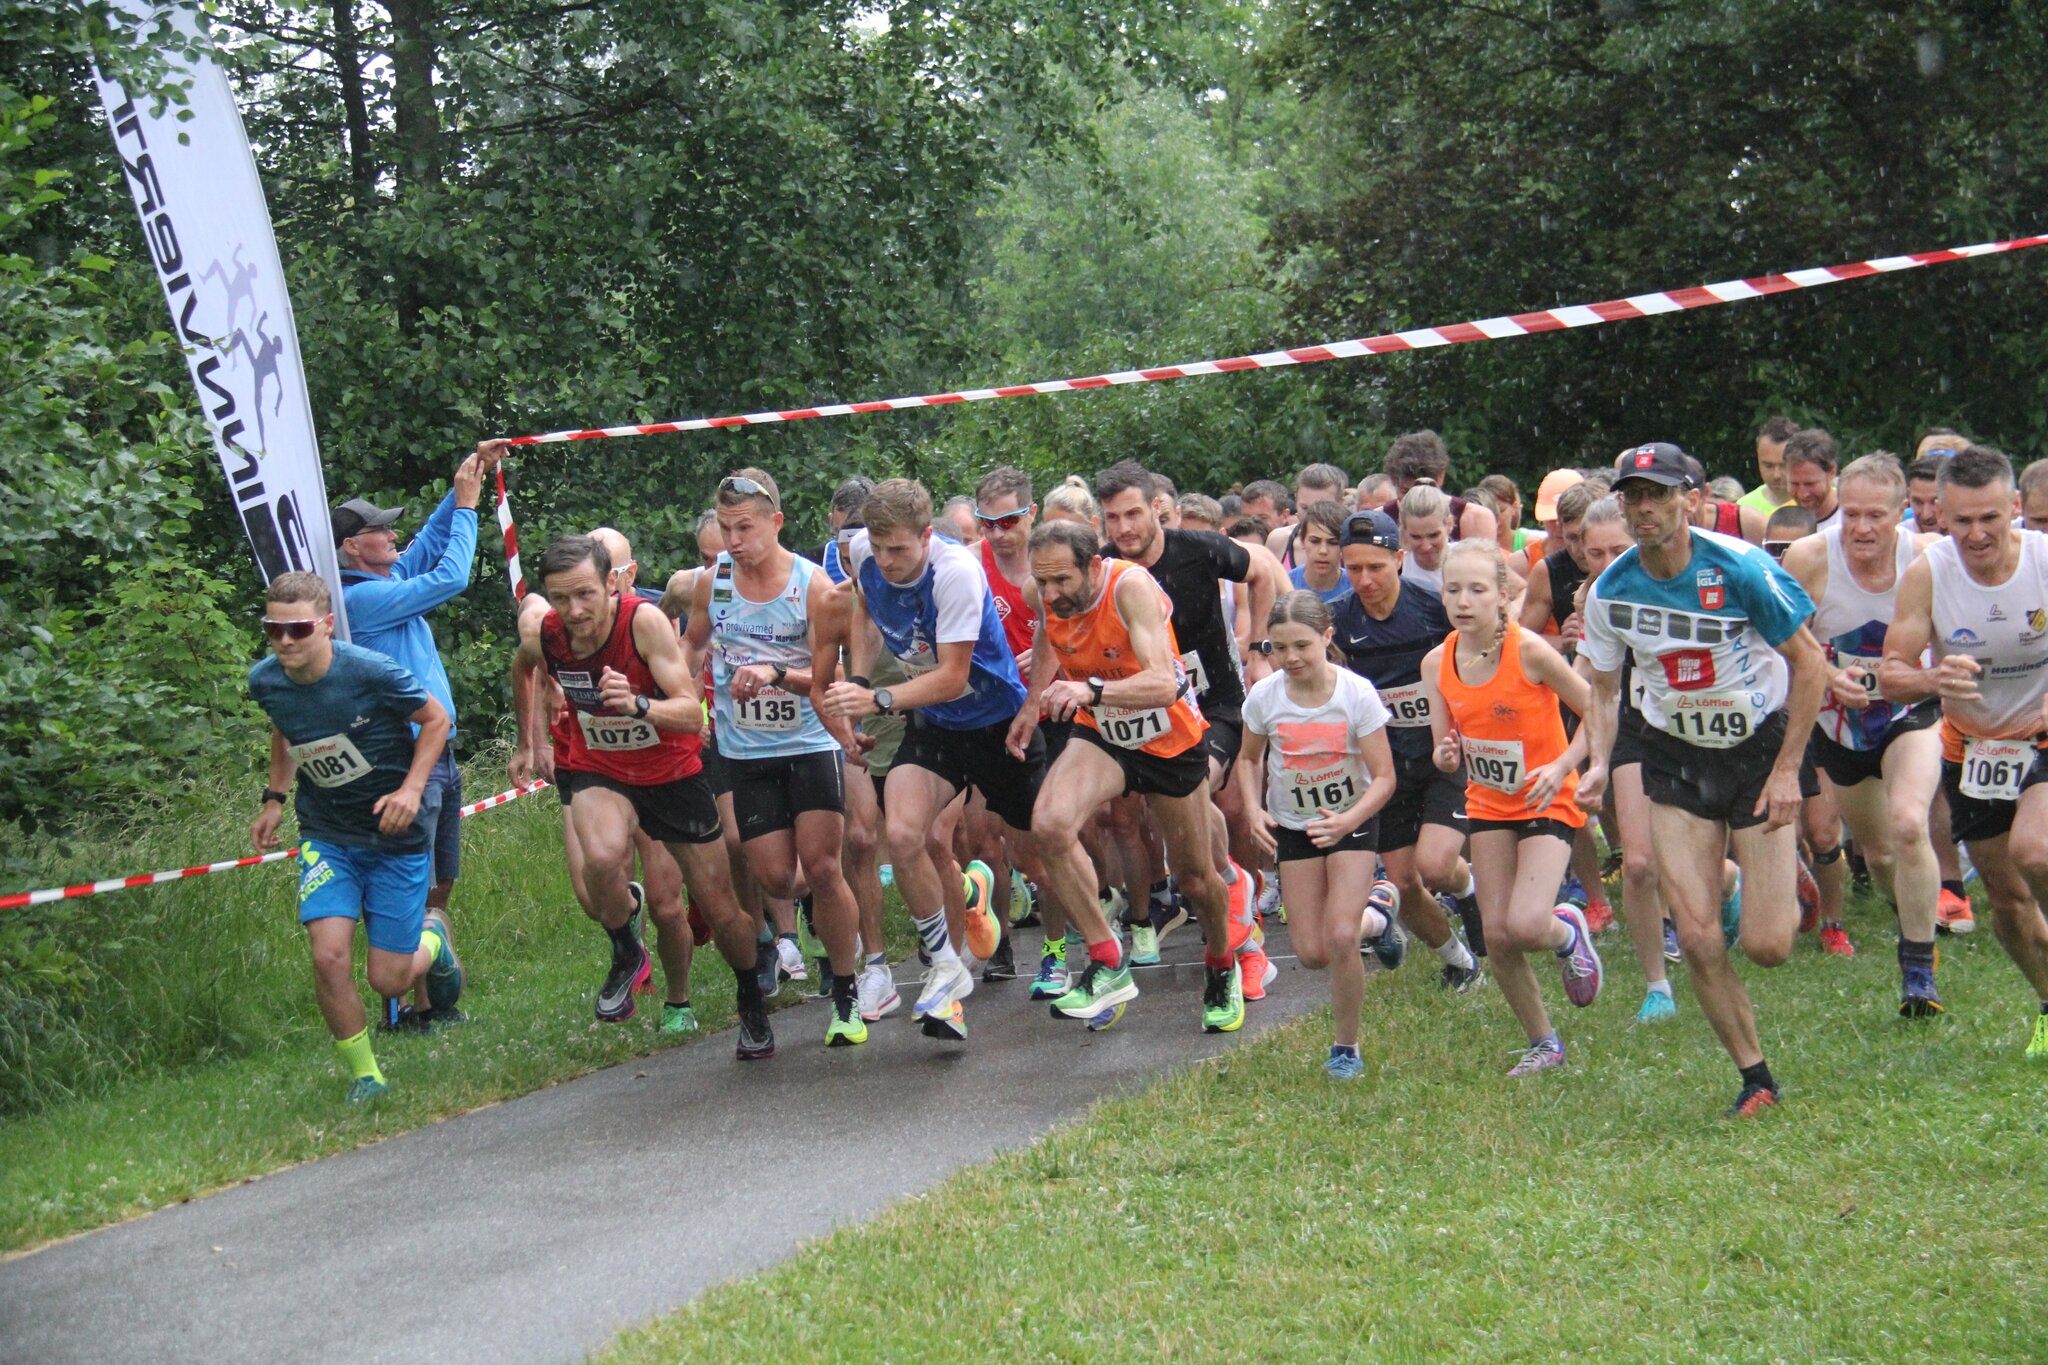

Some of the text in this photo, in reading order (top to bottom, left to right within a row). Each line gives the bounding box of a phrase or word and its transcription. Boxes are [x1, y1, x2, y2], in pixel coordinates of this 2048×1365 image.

[726, 622, 773, 635] provivamed
[1677, 657, 1701, 670] long
[1677, 667, 1701, 682] life
[737, 699, 796, 722] 1135
[1385, 696, 1430, 719] 169
[1695, 698, 1735, 707] Löffler
[586, 724, 651, 744] 1073
[1101, 711, 1162, 742] 1071
[1670, 711, 1748, 738] 1149
[302, 750, 358, 780] 1081
[1310, 767, 1345, 783] Löffler
[1466, 753, 1518, 785] 1097
[1967, 757, 2025, 788] 1061
[1290, 775, 1355, 808] 1161
